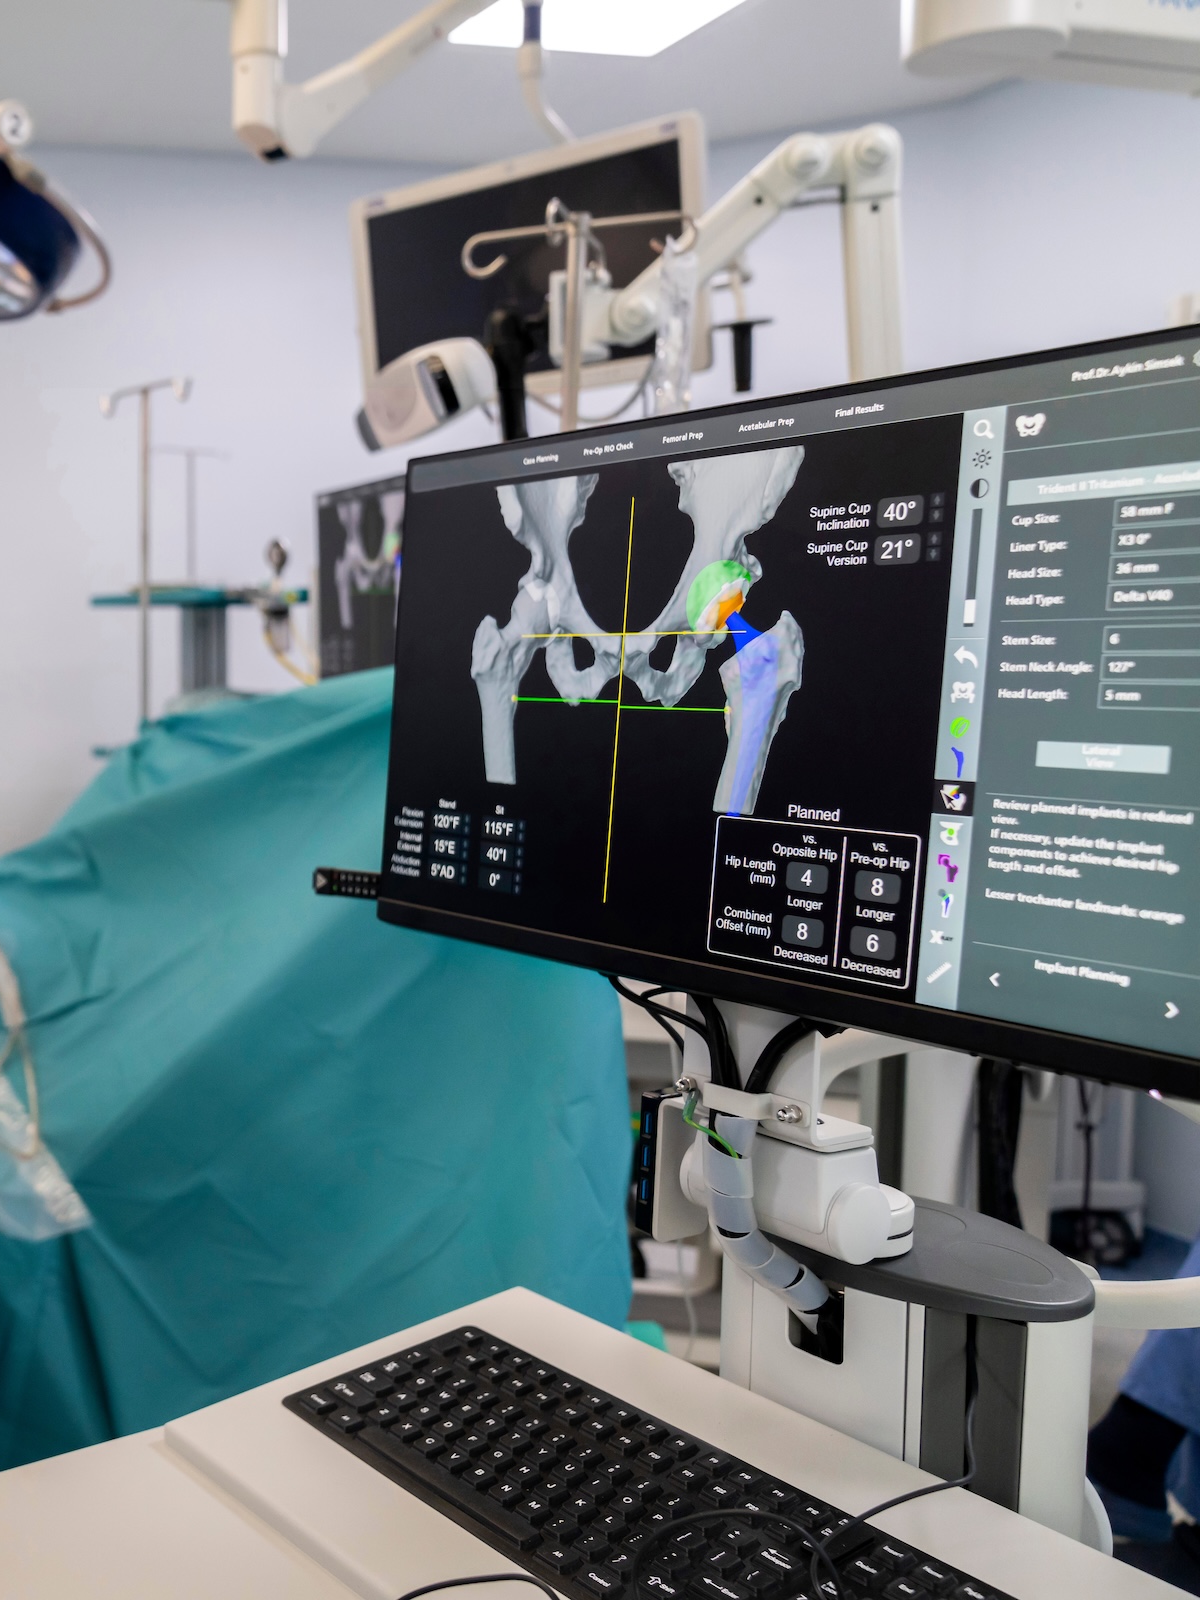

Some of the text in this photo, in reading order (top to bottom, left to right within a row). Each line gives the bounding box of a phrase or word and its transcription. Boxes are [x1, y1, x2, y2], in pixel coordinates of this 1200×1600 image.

[834, 402, 884, 418] Final Results
[738, 416, 795, 433] Acetabular Prep
[662, 431, 704, 444] Femoral Prep
[583, 447, 603, 457] Pre-Op
[616, 441, 634, 451] Check
[523, 453, 559, 466] Case Planning
[1037, 482, 1077, 496] Trident
[1088, 476, 1144, 490] Tritanium
[809, 502, 871, 519] Supine Cup
[883, 500, 917, 521] 40°
[816, 517, 870, 532] Inclination
[1012, 513, 1061, 527] Cup Size:
[806, 540, 868, 555] Supine Cup
[880, 539, 913, 560] 21°
[1010, 540, 1069, 554] Liner Type:
[826, 554, 867, 566] Version
[1133, 562, 1160, 574] mm
[1007, 567, 1063, 579] Head Size:
[1005, 594, 1065, 607] Head Type:
[1113, 590, 1147, 603] Delta
[1002, 634, 1057, 646] Stem Size:
[1109, 633, 1120, 645] 6
[1000, 661, 1095, 675] Stem Neck Angle:
[998, 687, 1070, 702] Head Length:
[1081, 744, 1122, 757] Lateral
[1085, 756, 1116, 769] View
[439, 798, 457, 810] Stand
[495, 804, 505, 815] Sit
[993, 798, 1194, 826] Review planned implants in reduced
[787, 804, 841, 822] Planned
[991, 814, 1020, 825] view.
[433, 814, 460, 829] 120°F
[484, 820, 513, 836] 115°F
[434, 839, 456, 855] 15°E
[802, 834, 817, 845] vs.
[872, 842, 888, 852] vs.
[990, 828, 1165, 856] If necessary, update the implant
[772, 842, 838, 863] Opposite Hip
[988, 844, 1180, 876] components to achieve desired hip
[725, 855, 776, 872] Hip Length
[850, 851, 910, 871] Pre-op Hip
[987, 858, 1082, 878] length and offset.
[489, 872, 500, 887] 0°
[750, 872, 776, 887] (mm)
[800, 869, 812, 887] 4
[870, 877, 884, 897] 8
[787, 895, 823, 912] Longer
[985, 887, 1017, 902] Lesser
[1017, 889, 1074, 909] trochanter
[1138, 908, 1186, 926] orange
[724, 906, 773, 924] Combined
[856, 905, 895, 923] Longer
[715, 918, 771, 939] Offset (mm)
[796, 922, 808, 940] 8
[866, 934, 879, 953] 6
[773, 946, 828, 966] Decreased
[841, 958, 901, 979] Decreased
[1034, 959, 1132, 988] Implant Planning
